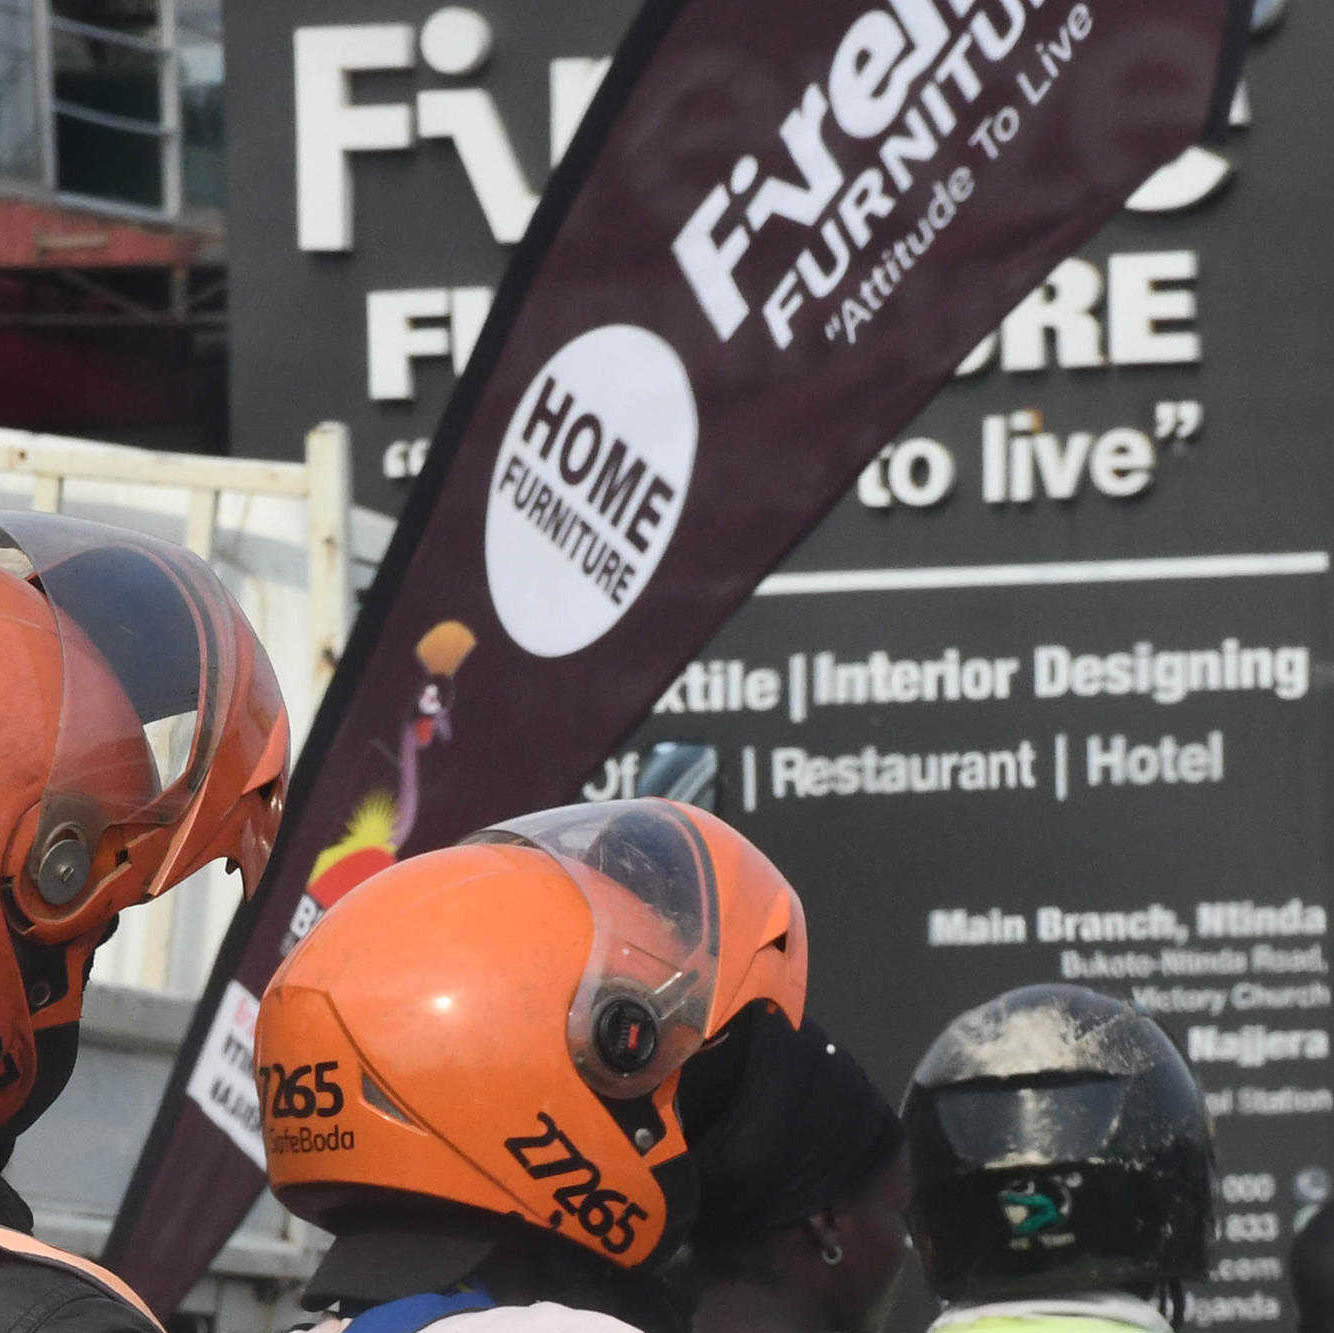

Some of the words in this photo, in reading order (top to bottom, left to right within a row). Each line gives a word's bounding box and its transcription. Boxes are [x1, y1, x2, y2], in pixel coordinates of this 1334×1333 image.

[762, 0, 1050, 350] FURNITU
[969, 105, 1020, 160] To
[521, 377, 675, 556] HOME
[498, 455, 638, 607] FURNITURE
[814, 647, 1019, 706] Interior
[1034, 641, 1310, 704] Designing
[771, 740, 1035, 798] Restaurant
[1086, 731, 1224, 786] Hotel
[928, 908, 1028, 947] Main
[1036, 903, 1189, 946] Branch,
[504, 1111, 649, 1256] 27265
